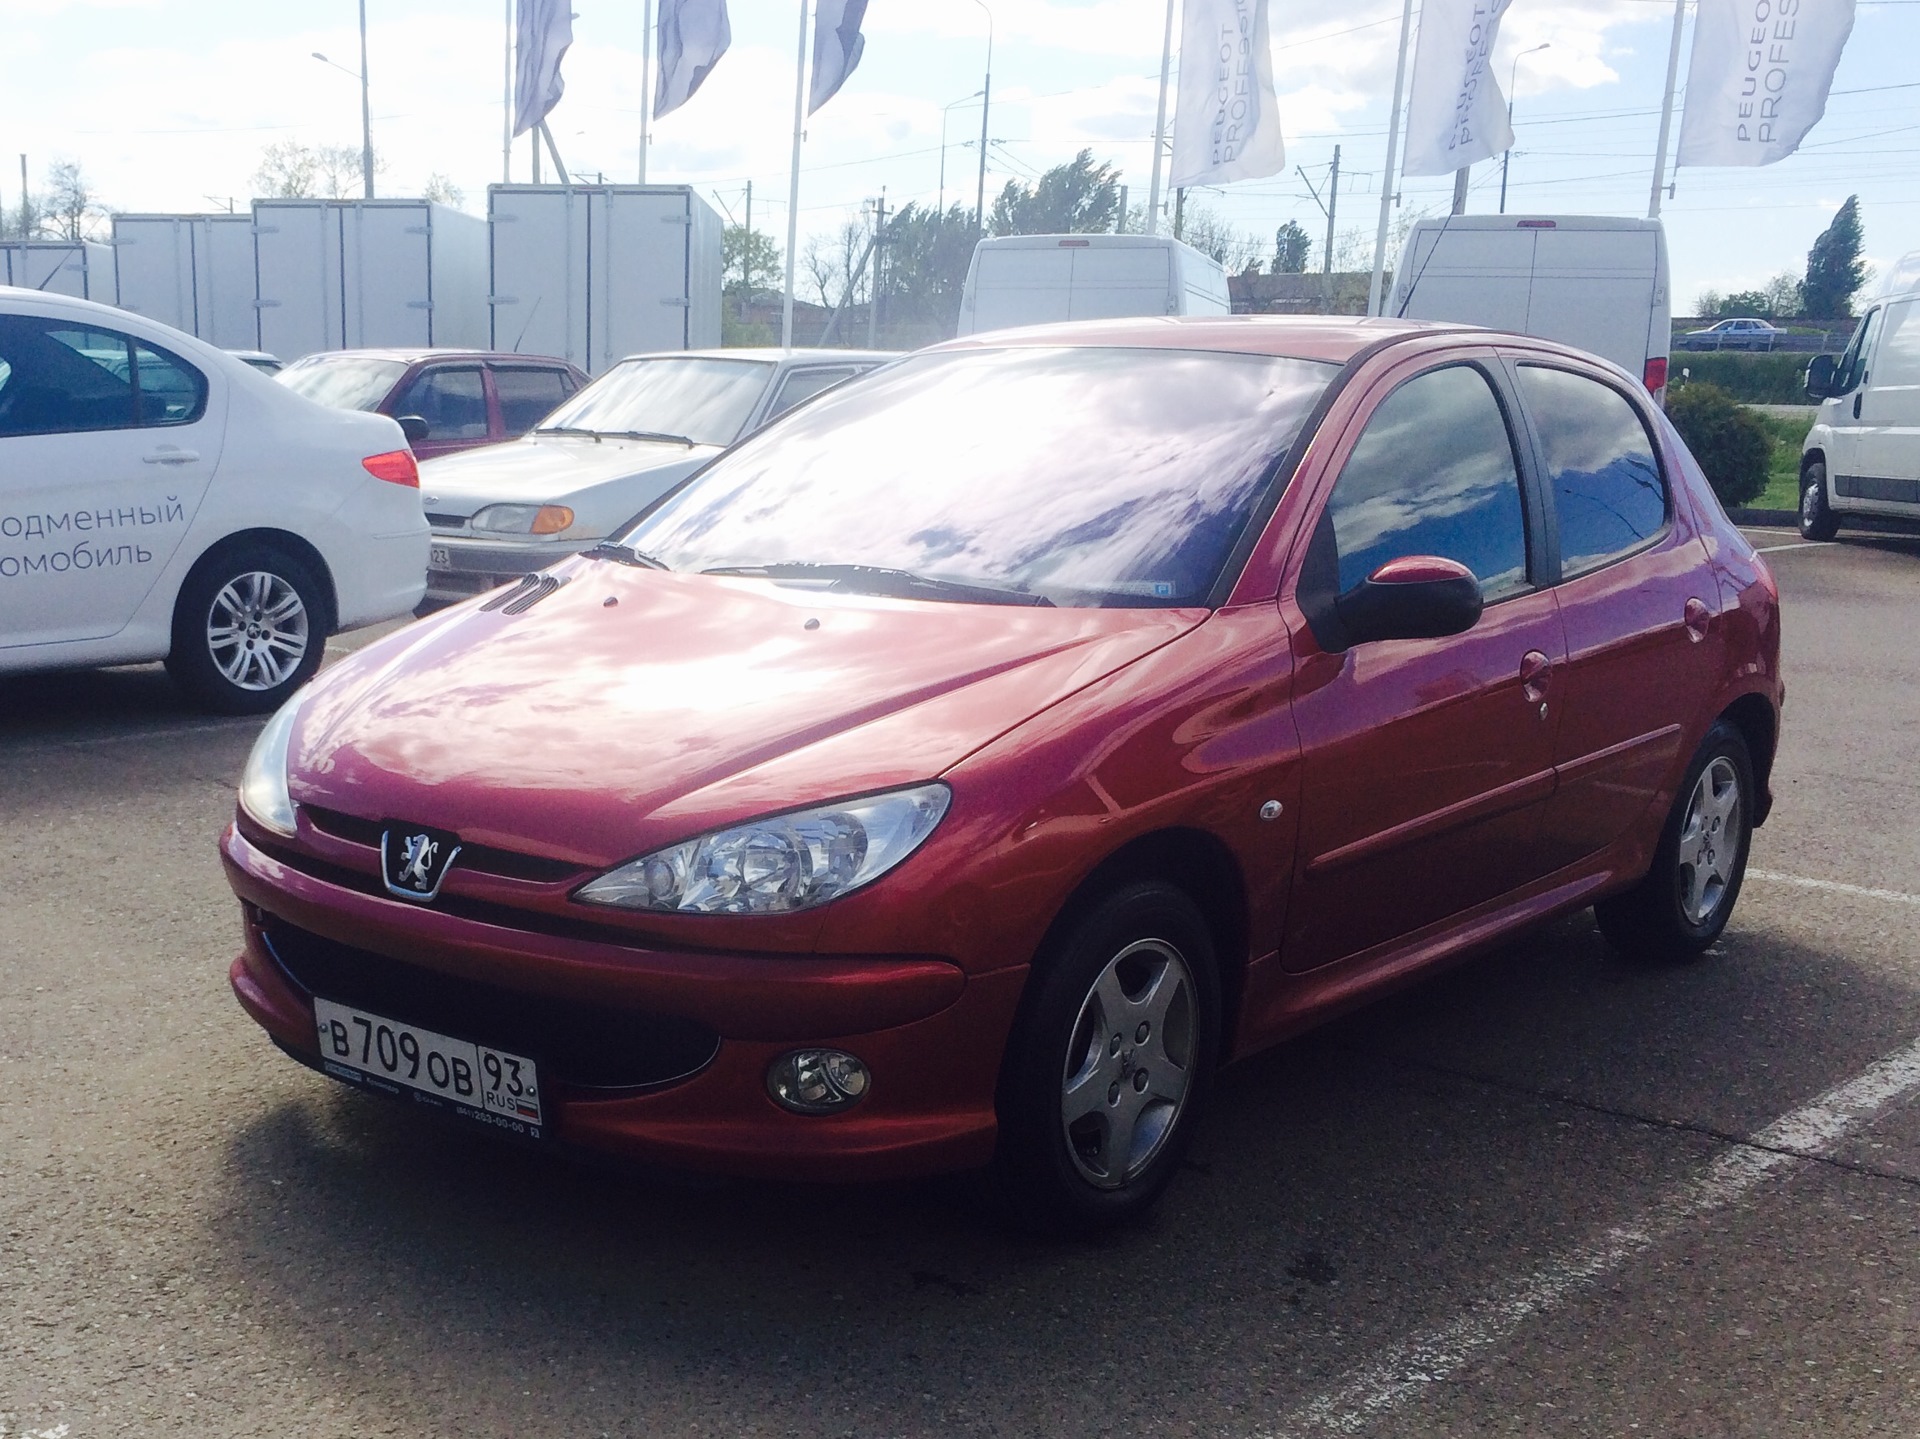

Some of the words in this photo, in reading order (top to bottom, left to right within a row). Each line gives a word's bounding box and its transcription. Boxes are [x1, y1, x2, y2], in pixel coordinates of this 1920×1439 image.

[1212, 24, 1234, 165] PEUGEOT
[2, 496, 184, 540] одменный
[486, 1091, 516, 1111] RUS
